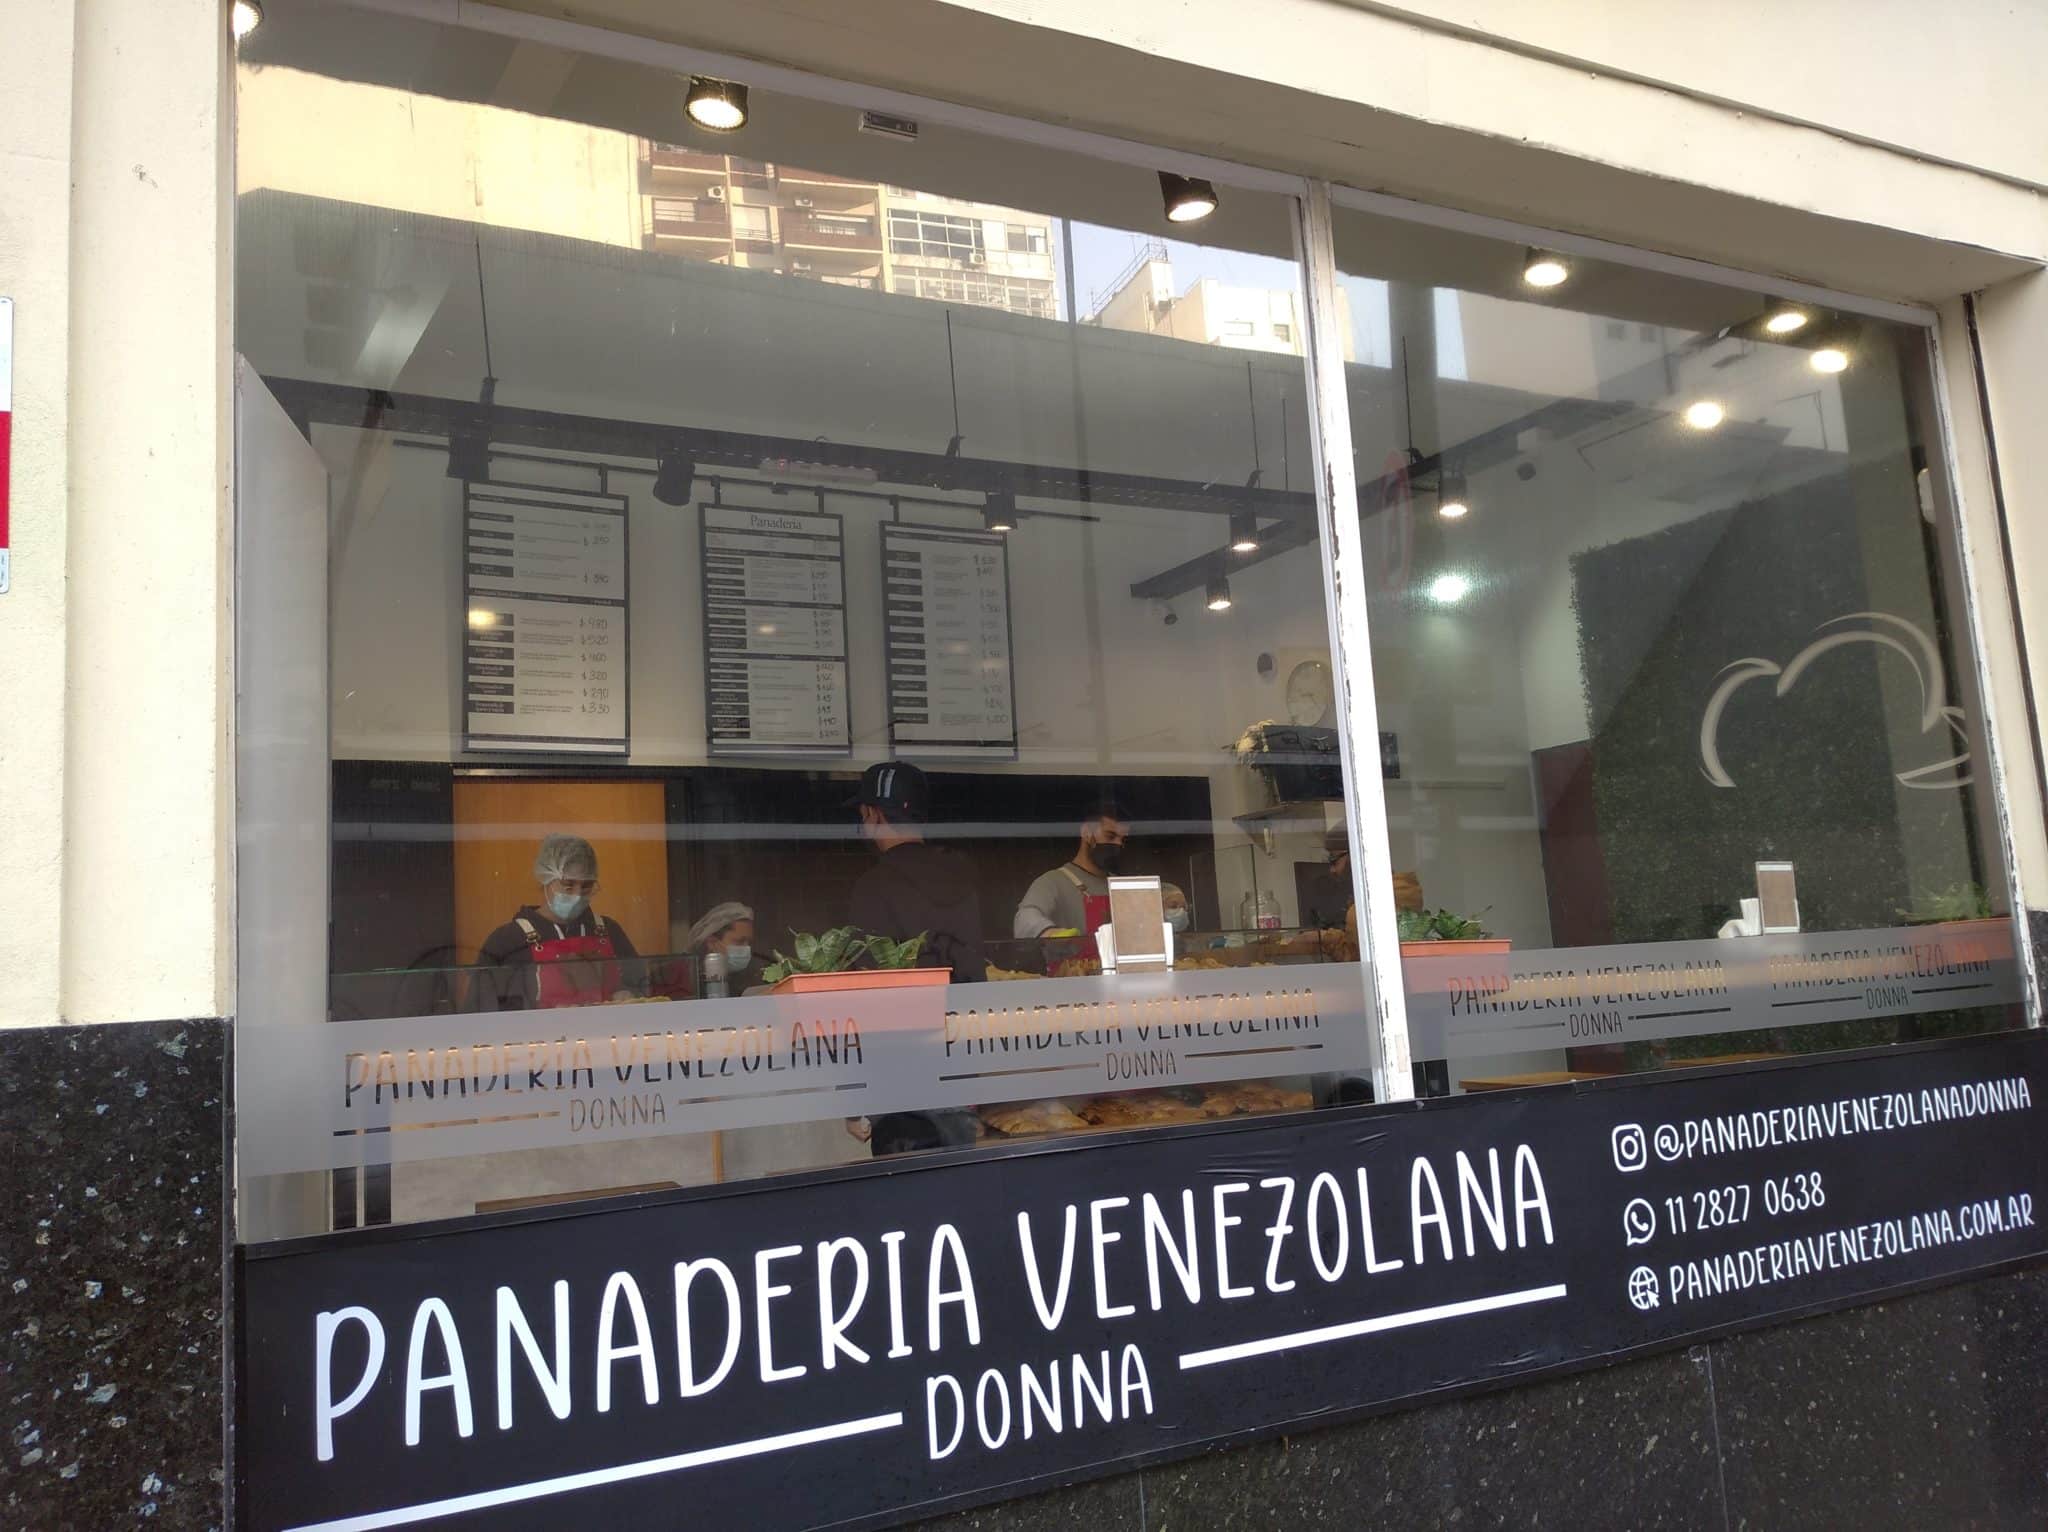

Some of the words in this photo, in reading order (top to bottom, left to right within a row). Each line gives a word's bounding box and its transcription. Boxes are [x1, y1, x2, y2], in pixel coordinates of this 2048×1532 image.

[1569, 1010, 1624, 1039] DONNA
[1866, 985, 1910, 1011] DONNA
[610, 1016, 863, 1085] VENEZOLANA
[1105, 1048, 1177, 1081] DONNA
[569, 1092, 666, 1133] DONNA
[1653, 1077, 2032, 1162] @PANADERIAVENEZOLANADONNA
[1665, 1196, 1687, 1235] 11
[1692, 1185, 1751, 1230] 2827
[1764, 1171, 1826, 1216] 0638
[1669, 1193, 2035, 1305] PANADERIAVENEZOLANA.COM.AR
[317, 1224, 980, 1462] PANADERIA
[1018, 1144, 1554, 1331] VENEZOLANA
[927, 1344, 1154, 1460] DONNA
